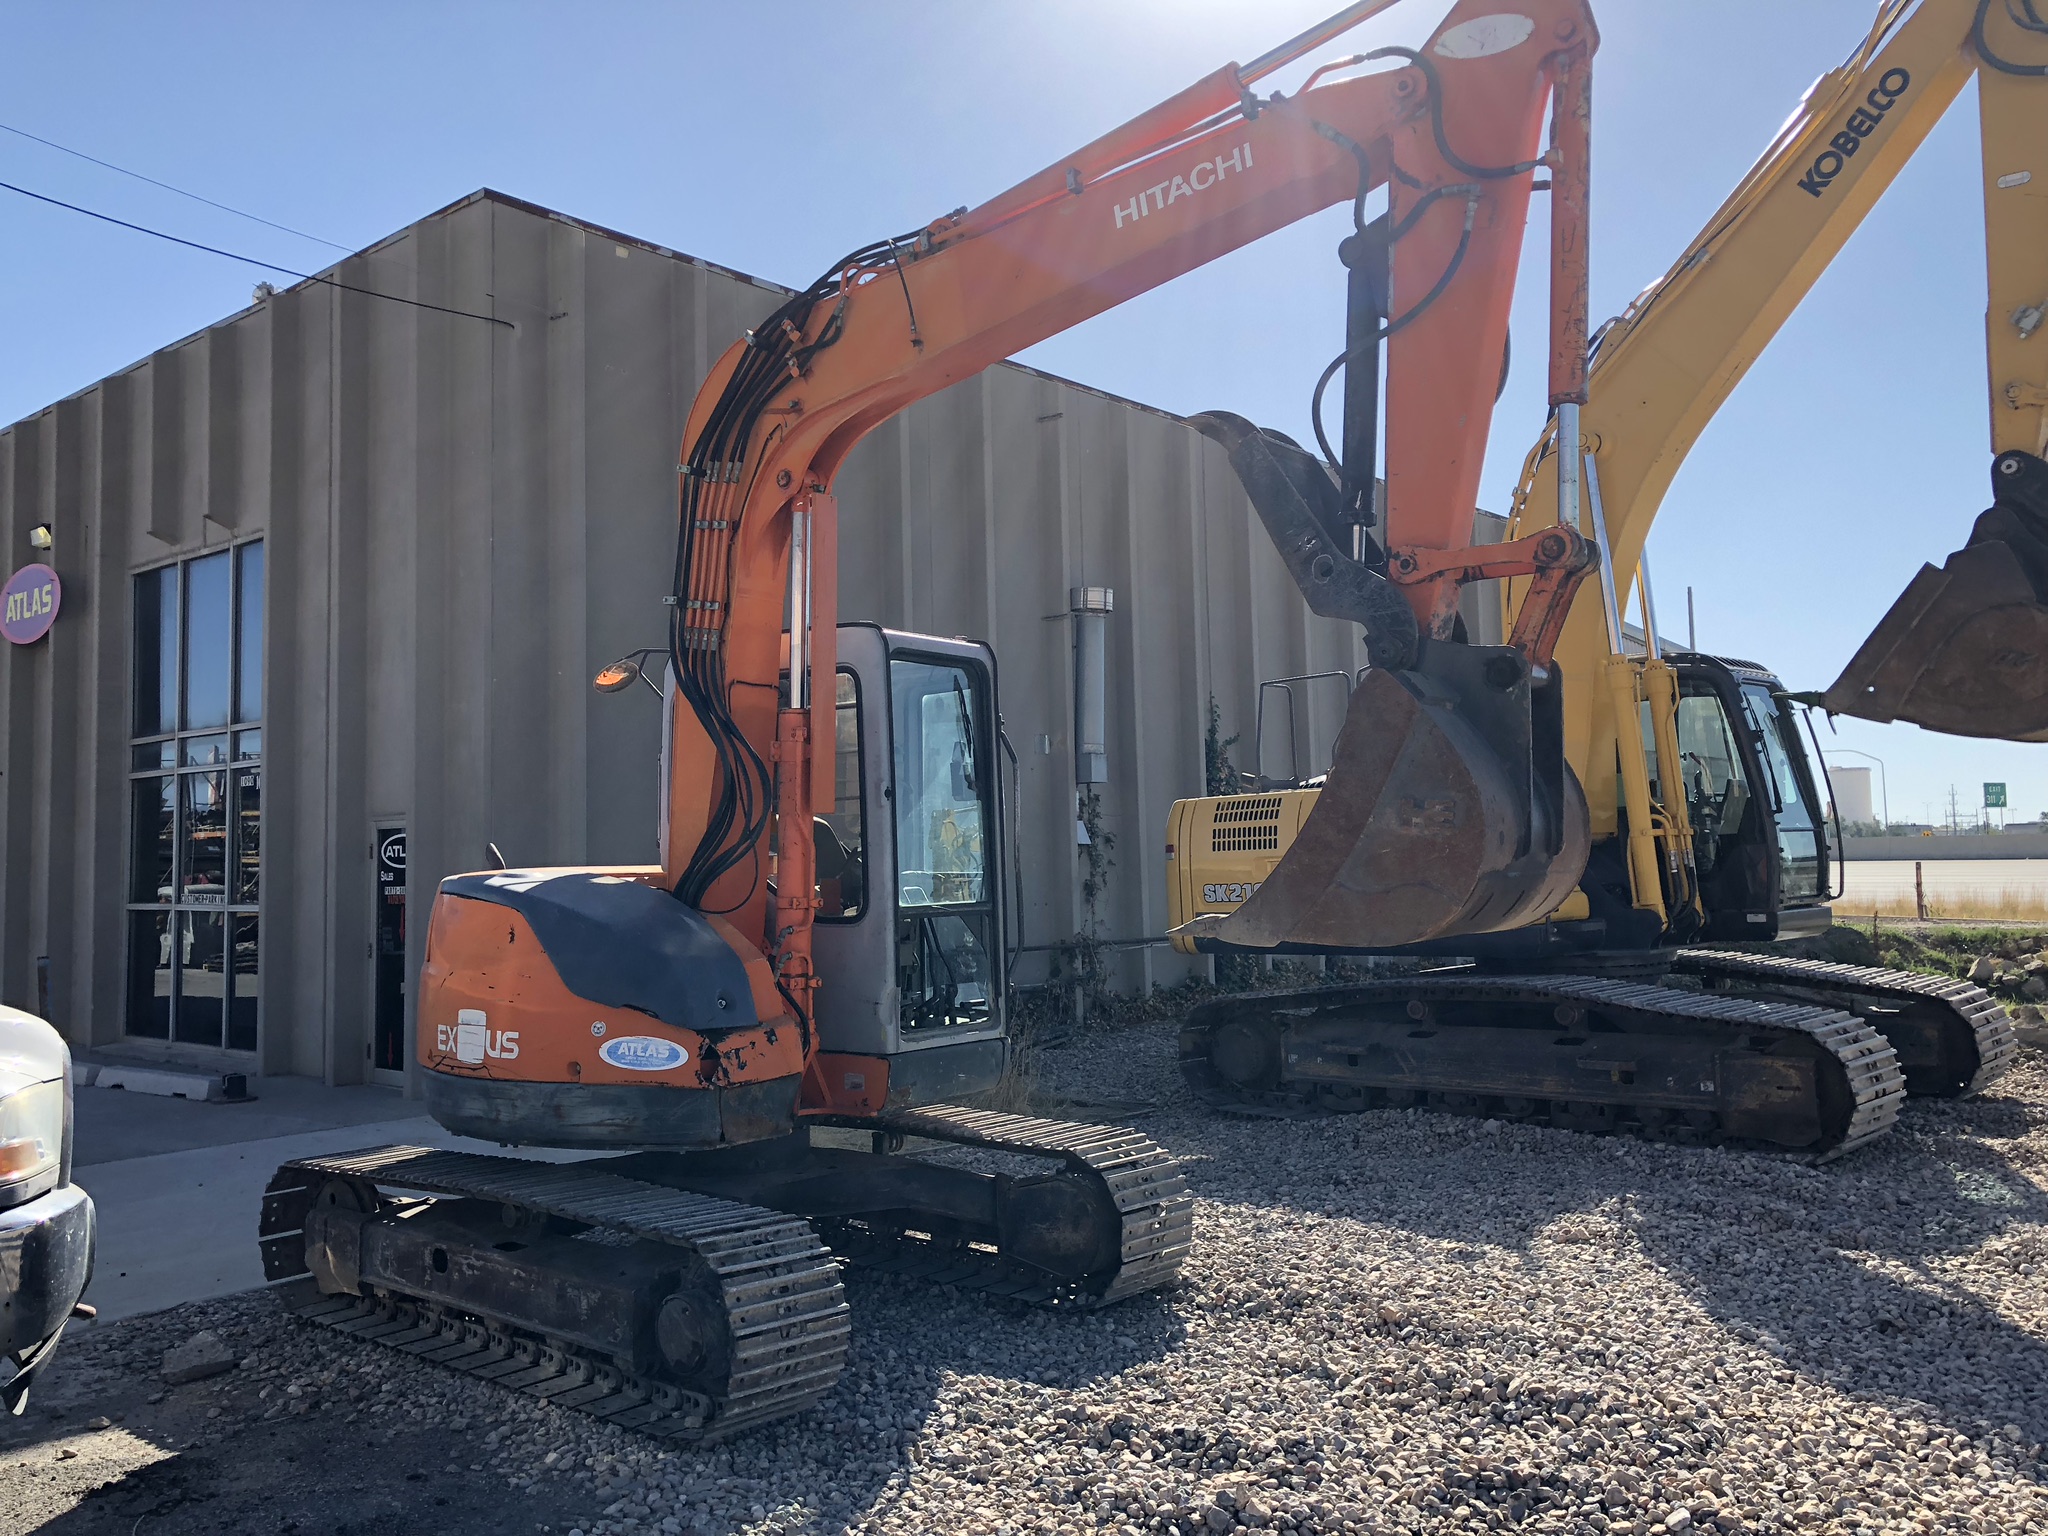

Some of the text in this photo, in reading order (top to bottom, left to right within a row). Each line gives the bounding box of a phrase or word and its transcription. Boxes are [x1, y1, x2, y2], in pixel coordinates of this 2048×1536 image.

[1797, 67, 1910, 198] KOBELCO
[1113, 142, 1254, 229] HITACHI
[6, 584, 52, 623] ATLAS
[385, 845, 406, 858] ATL
[618, 1042, 670, 1058] ATLAS
